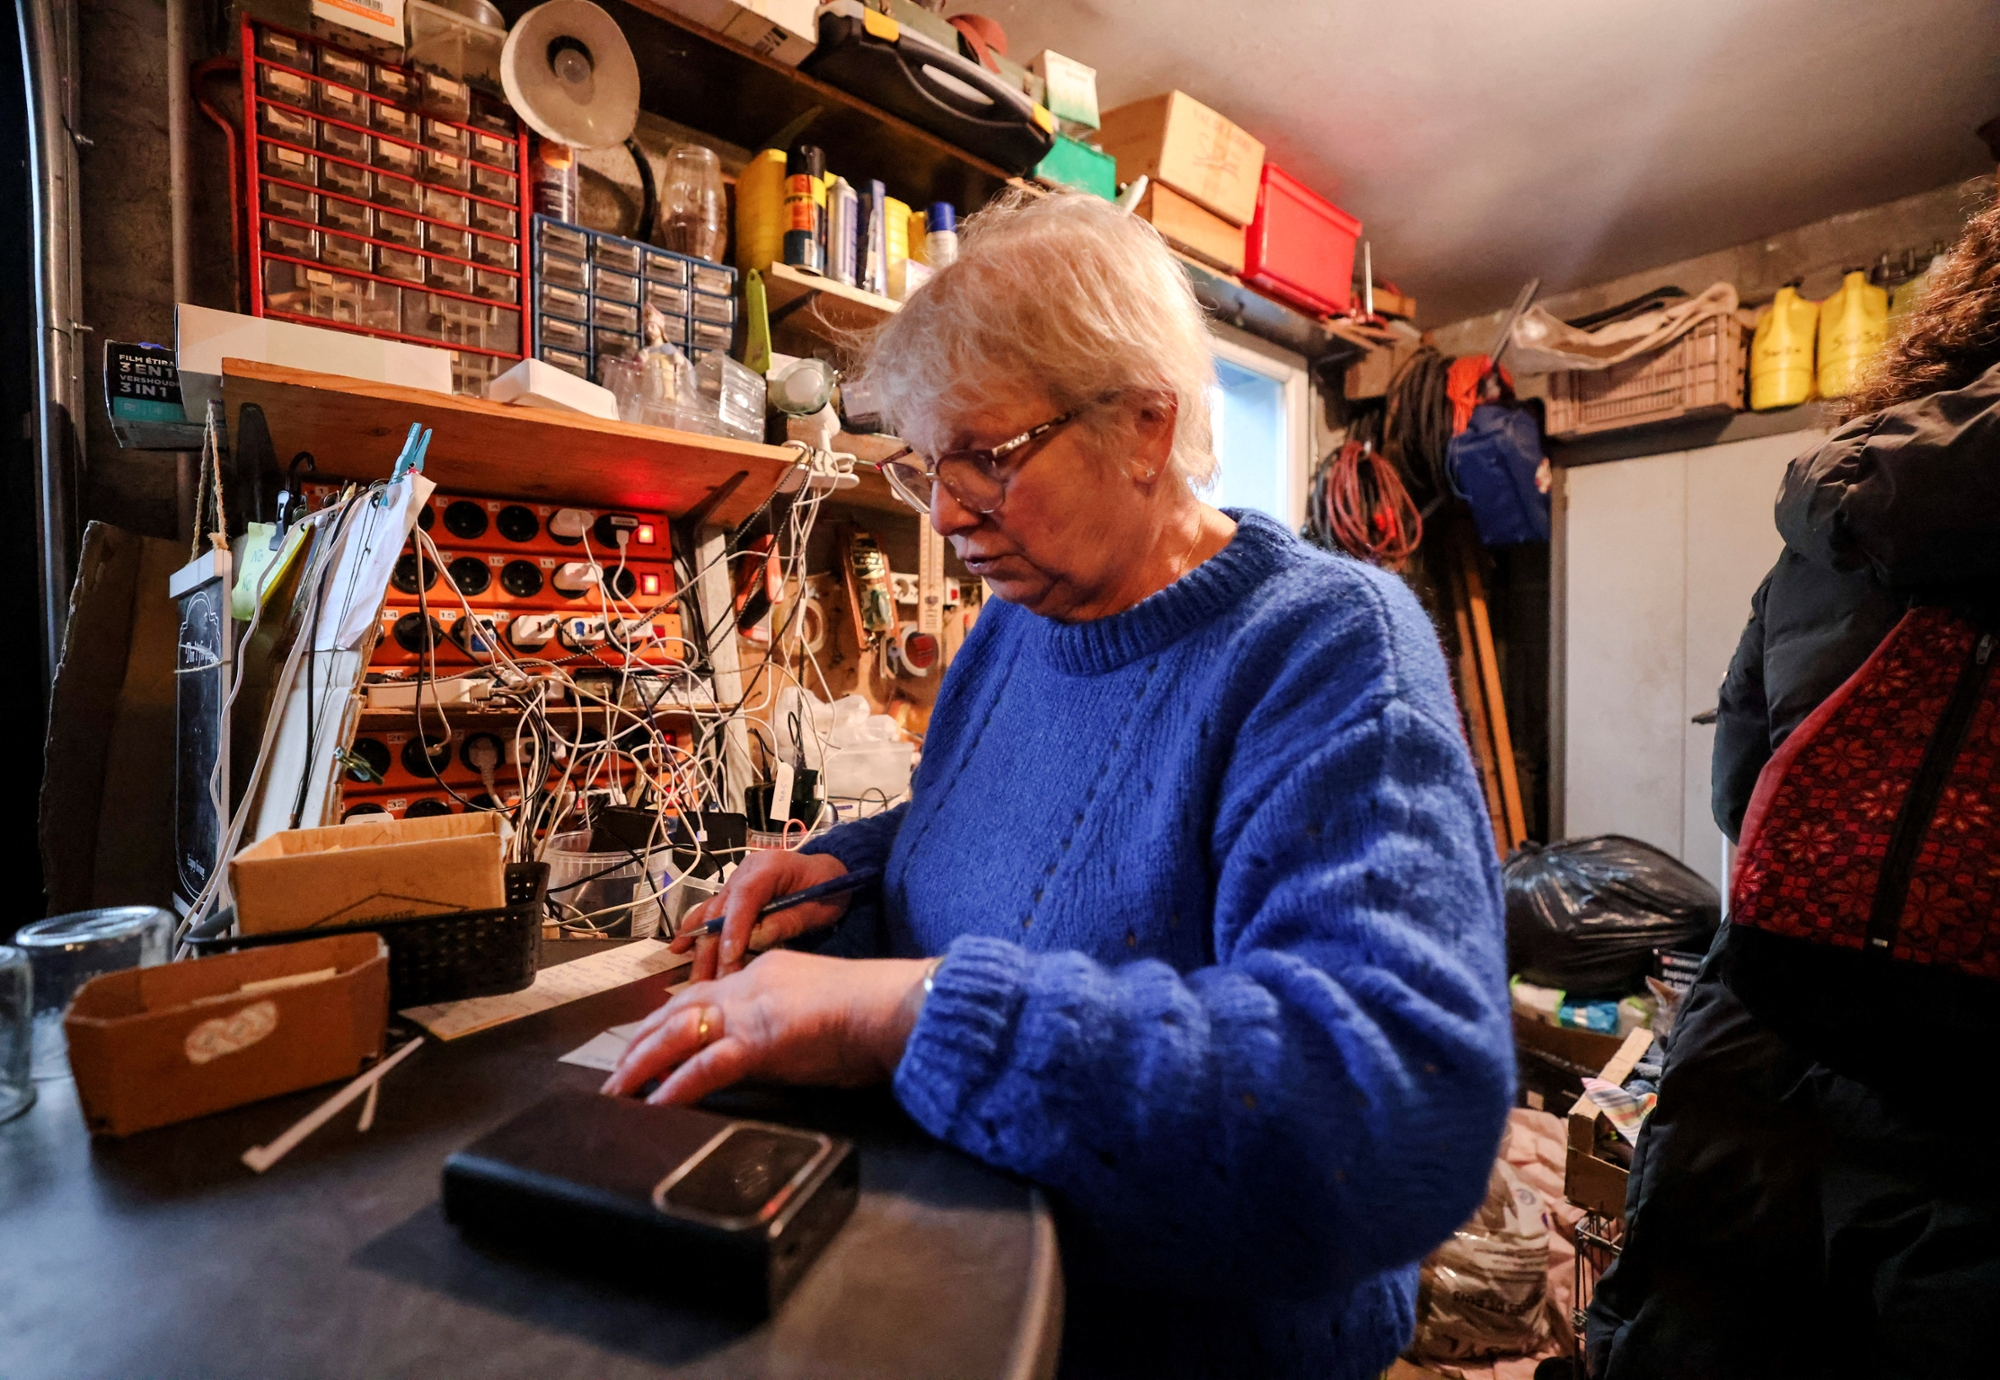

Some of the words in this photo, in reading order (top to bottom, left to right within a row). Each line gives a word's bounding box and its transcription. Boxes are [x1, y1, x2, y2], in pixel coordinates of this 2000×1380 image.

[119, 354, 143, 363] FILM
[120, 361, 131, 373] 3
[135, 363, 162, 377] EN
[165, 367, 173, 378] 1
[120, 381, 132, 393] 3
[135, 384, 156, 396] IN
[159, 386, 167, 398] 1
[383, 611, 398, 619] 14
[440, 611, 455, 619] 15
[388, 733, 406, 742] 26
[388, 800, 406, 809] 32
